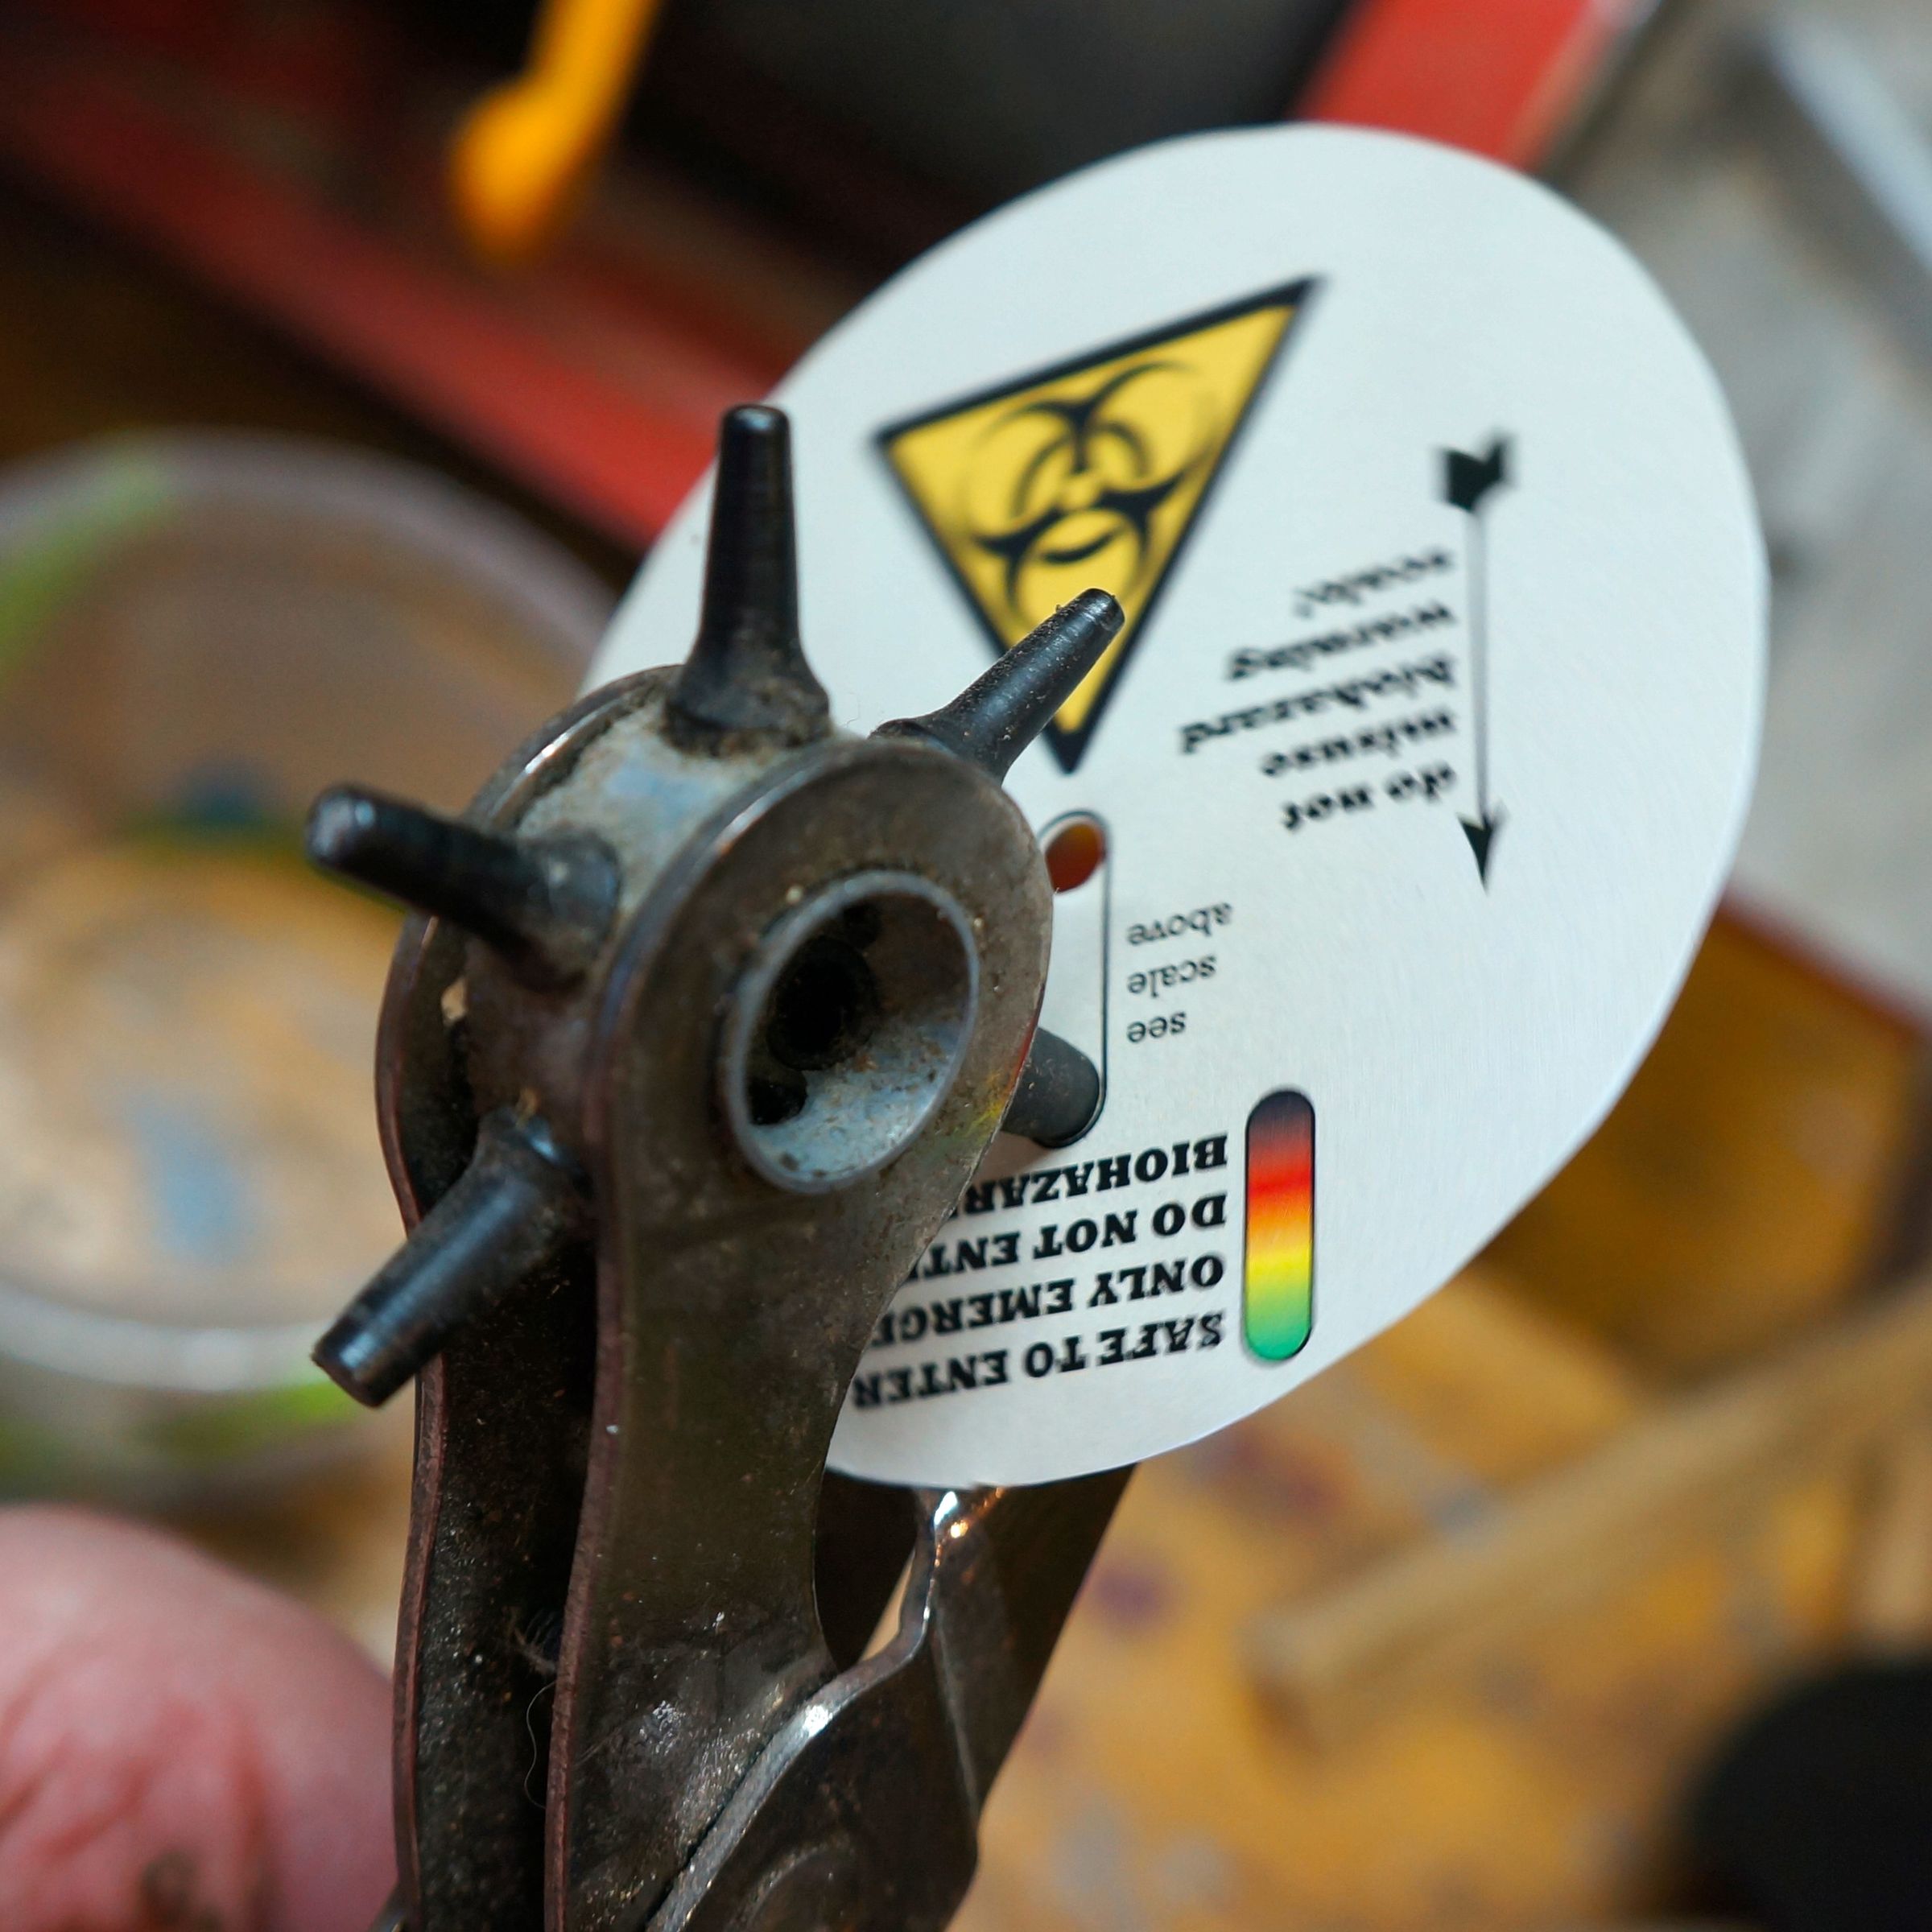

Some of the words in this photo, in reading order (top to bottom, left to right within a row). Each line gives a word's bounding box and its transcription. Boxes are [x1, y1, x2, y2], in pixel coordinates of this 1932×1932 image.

[1225, 603, 1455, 681] warning
[1180, 656, 1454, 753] biohazard
[1261, 711, 1455, 777] misuse
[1383, 762, 1456, 803] do
[1282, 786, 1373, 833] not
[1127, 902, 1232, 945] above
[1127, 955, 1216, 998] scale
[1127, 1011, 1187, 1043] see
[950, 1133, 1228, 1218] BIOHAZAR
[1033, 1211, 1137, 1260] NOT
[1152, 1195, 1227, 1236] DO
[905, 1232, 1021, 1282] ENT
[1088, 1254, 1224, 1308] ONLY
[1025, 1336, 1086, 1378] TO
[1097, 1311, 1224, 1367] SAFE
[852, 1350, 1009, 1409] ENTER
